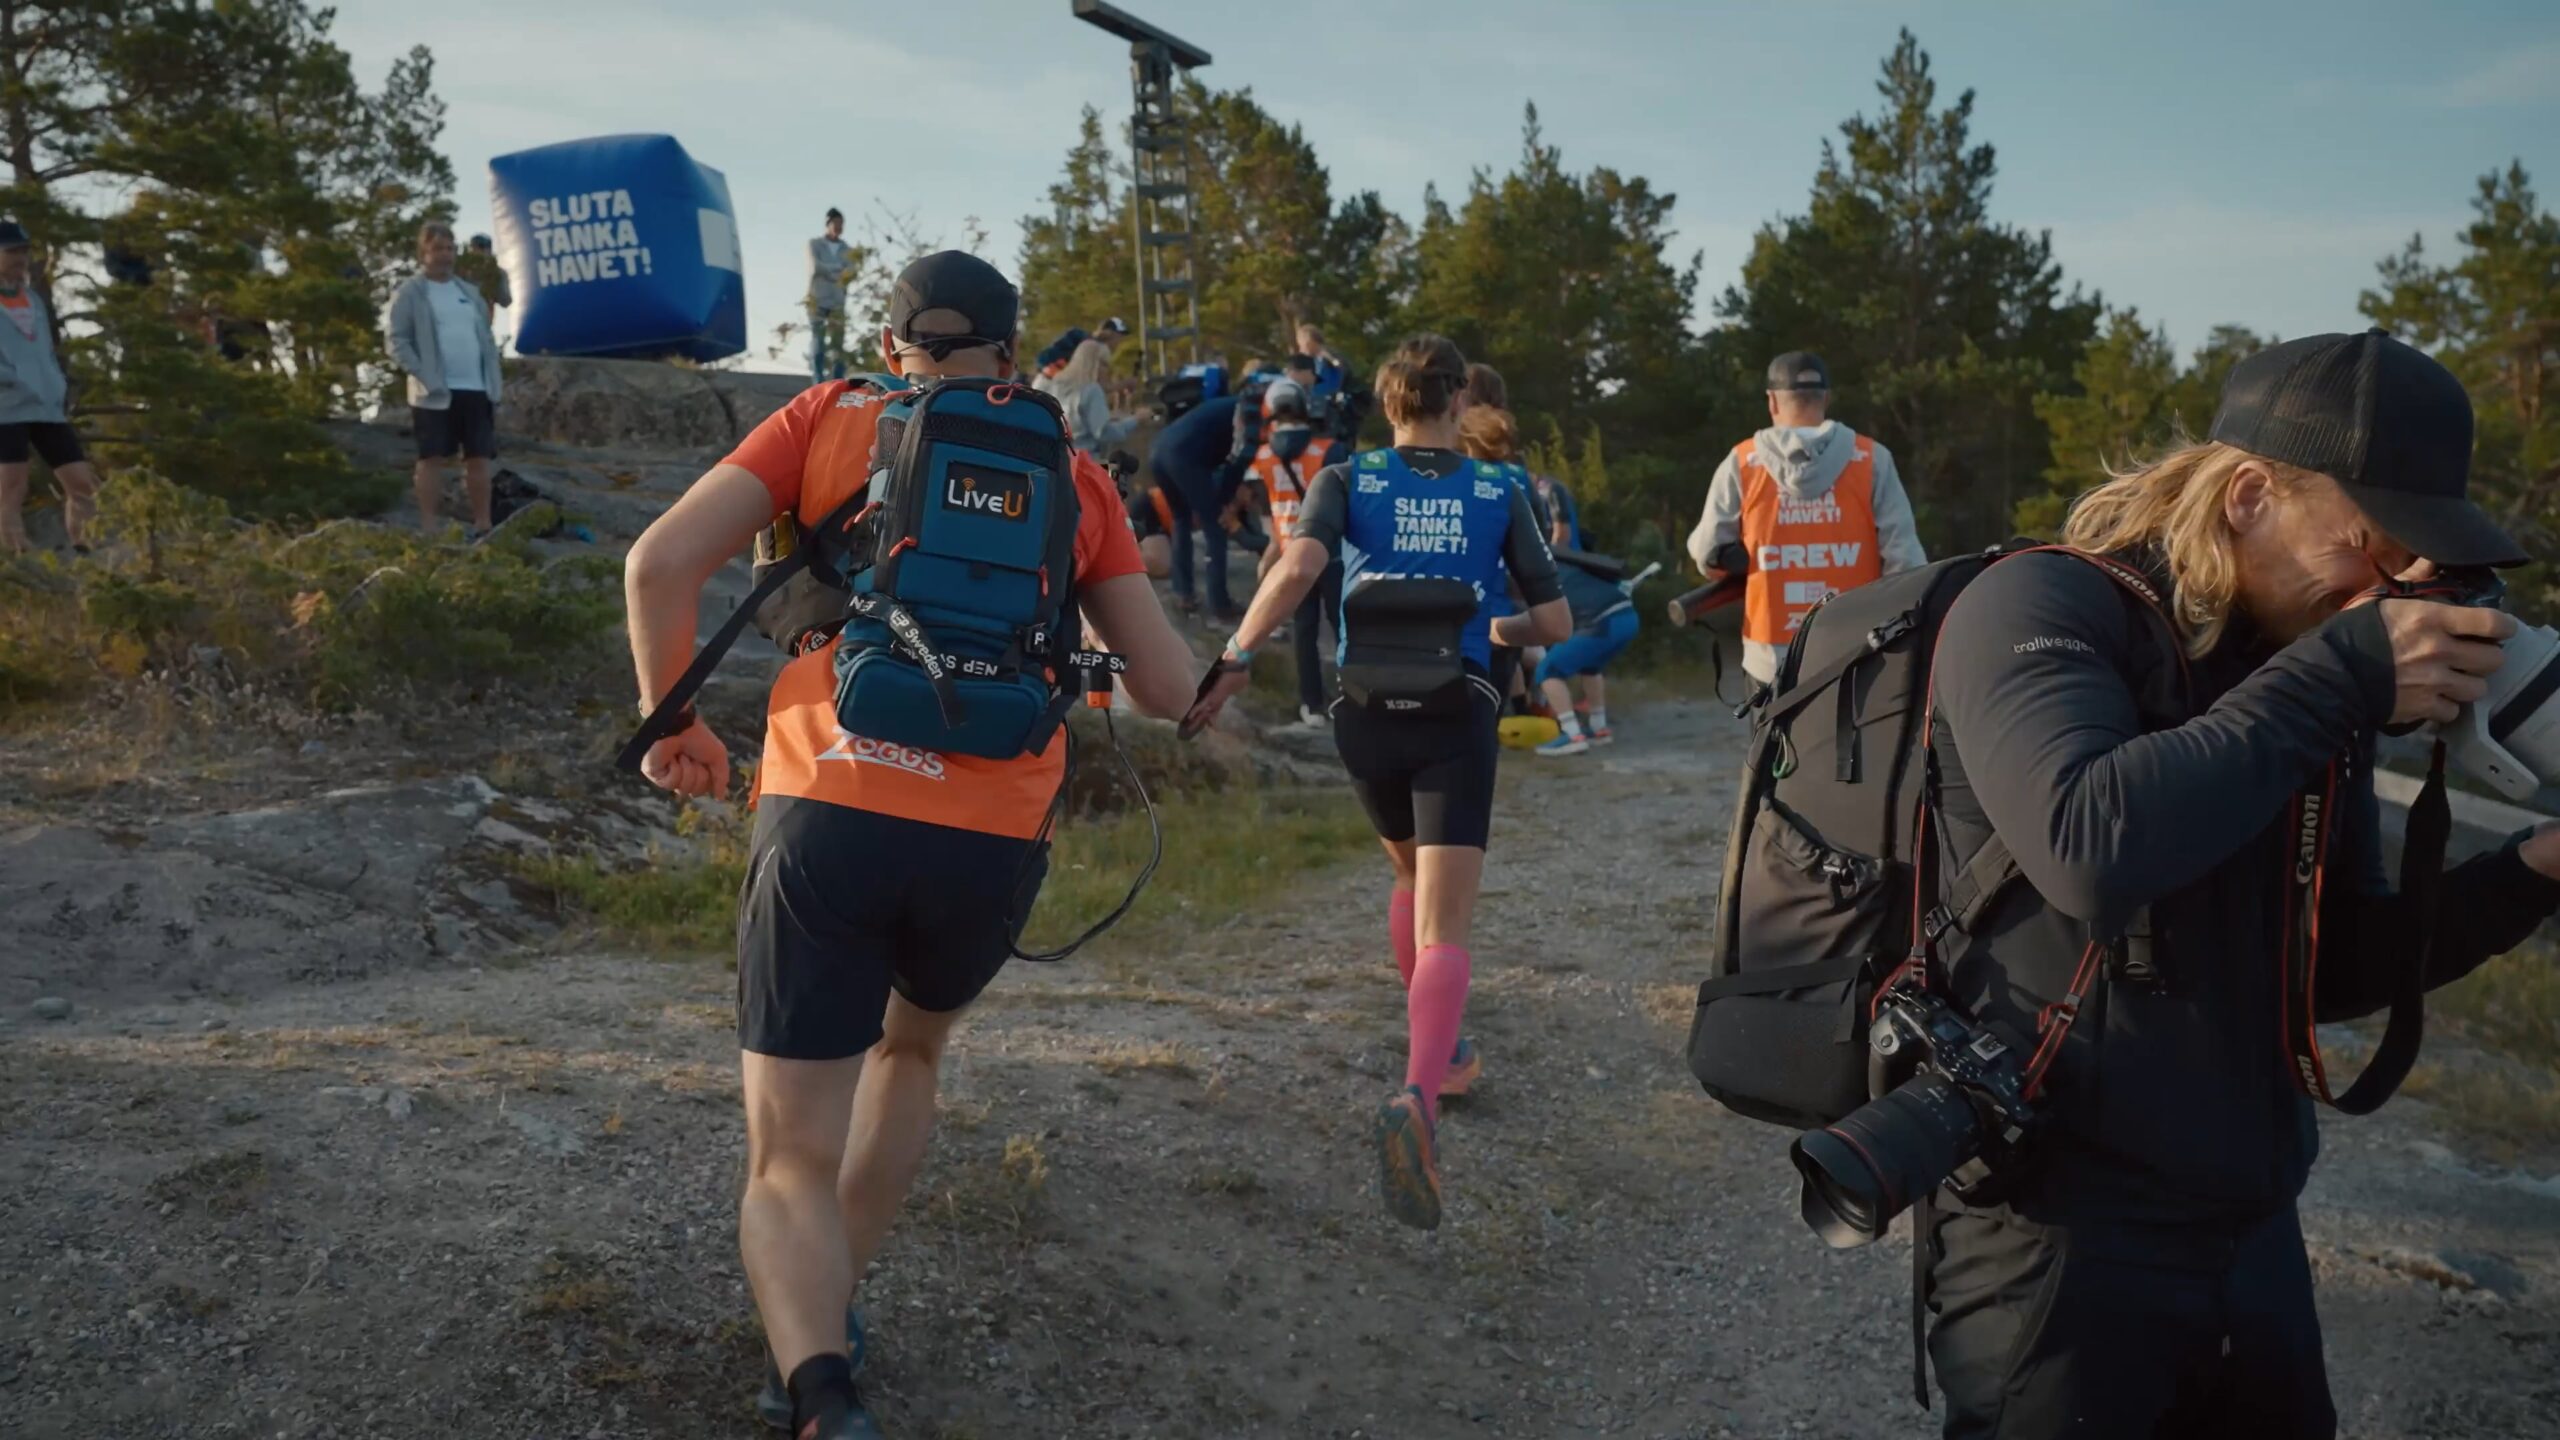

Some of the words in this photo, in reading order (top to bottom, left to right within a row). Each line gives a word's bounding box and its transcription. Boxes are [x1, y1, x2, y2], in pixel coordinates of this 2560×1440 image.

[529, 189, 634, 228] SLUTA
[534, 219, 639, 257] TANKA
[537, 247, 652, 288] HAVET!
[948, 477, 1023, 517] LiveU
[1395, 497, 1463, 517] SLUTA
[1395, 516, 1463, 535] TANKA
[1778, 506, 1841, 525] HAVET!
[1393, 535, 1468, 555] HAVET!
[1757, 542, 1862, 571] CREW
[905, 627, 944, 680] Sweden
[1069, 651, 1103, 666] NEP
[2296, 795, 2320, 884] Canon
